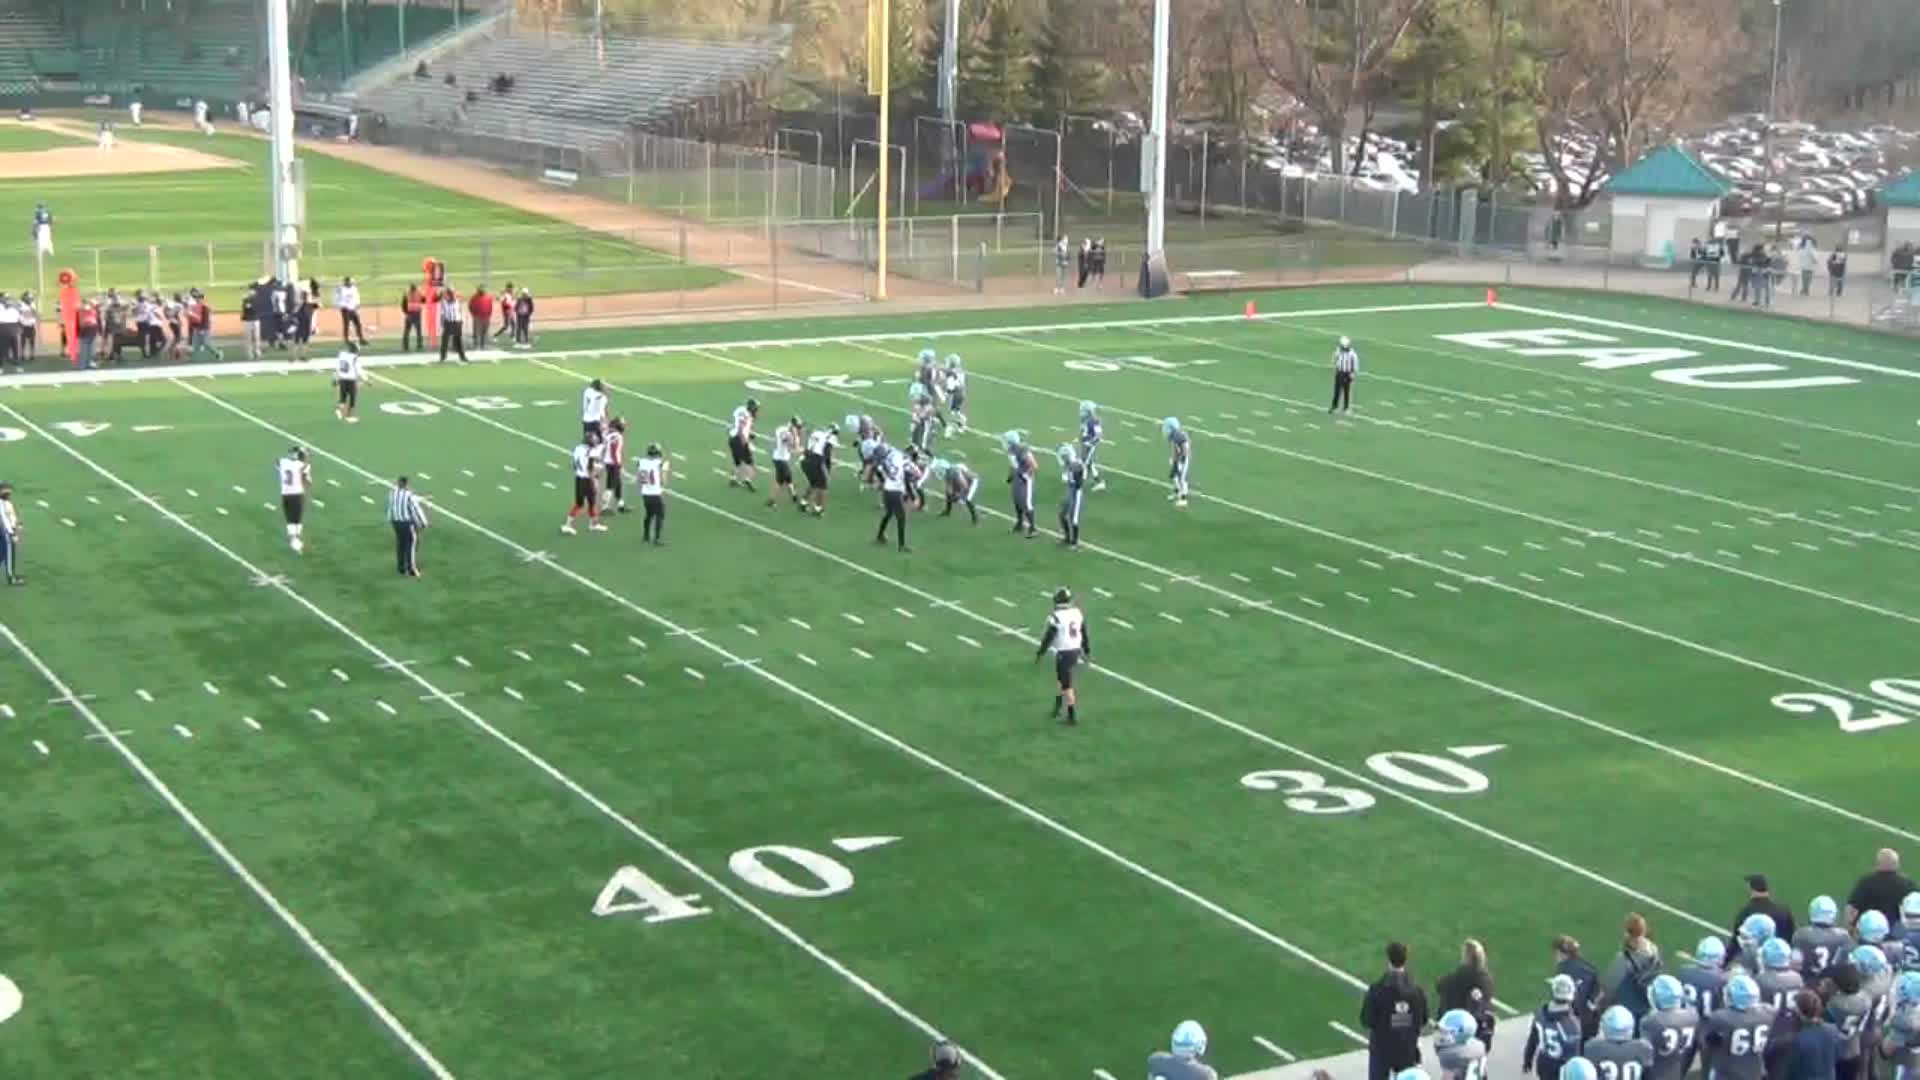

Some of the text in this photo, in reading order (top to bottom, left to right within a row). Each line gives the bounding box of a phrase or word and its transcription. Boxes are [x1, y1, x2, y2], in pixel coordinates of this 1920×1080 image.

[1432, 328, 1862, 389] EAU
[1240, 751, 1489, 814] 30
[592, 845, 855, 923] 40
[1659, 1026, 1696, 1056] 37
